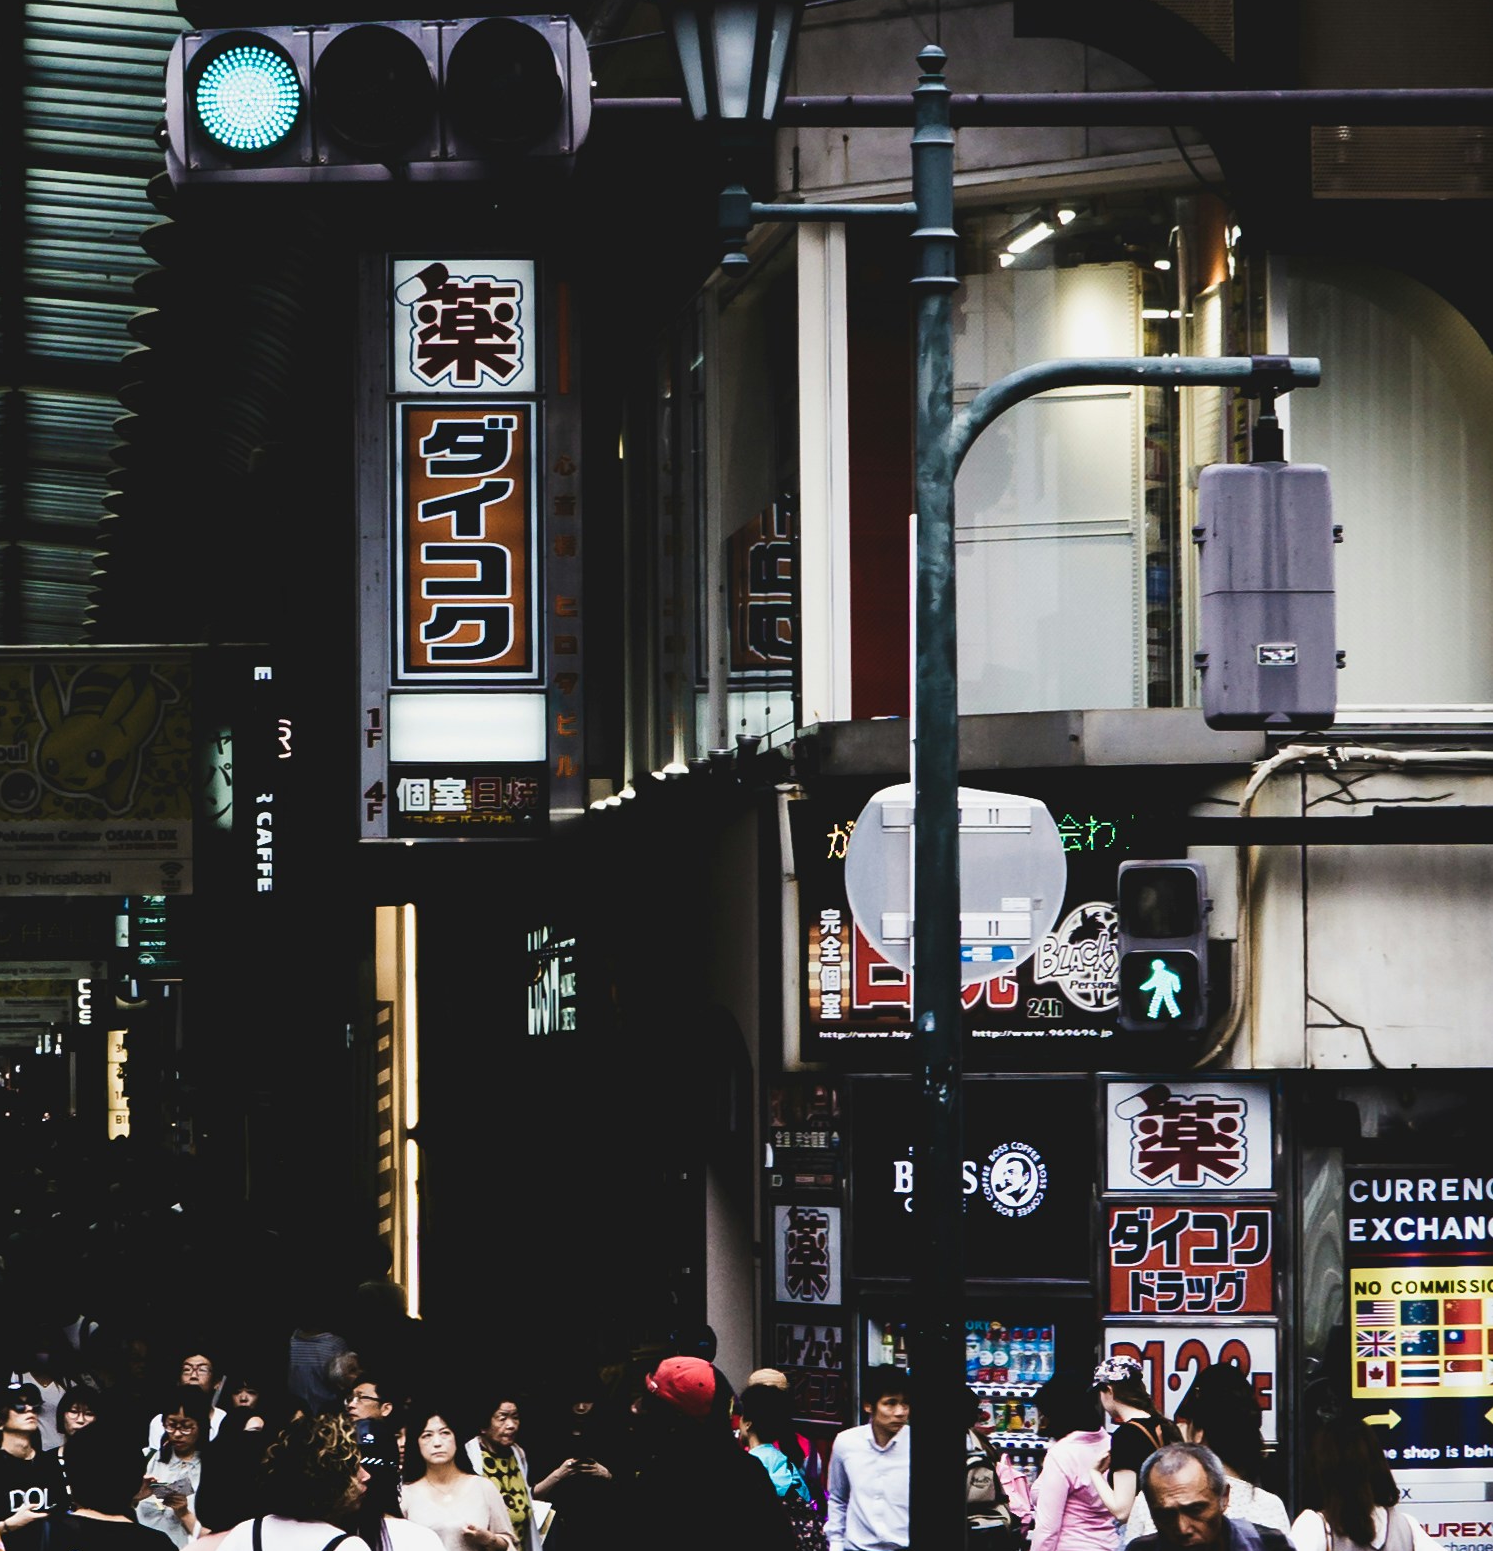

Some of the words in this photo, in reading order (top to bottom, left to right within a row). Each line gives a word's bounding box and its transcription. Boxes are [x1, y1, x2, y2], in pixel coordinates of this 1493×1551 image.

[414, 278, 520, 385] 薬
[418, 415, 518, 664] ダイコク
[366, 707, 383, 749] 1F
[364, 779, 386, 822] 4F
[256, 811, 273, 892] CAFFE
[7, 872, 20, 885] to
[26, 870, 111, 885] Shinsaibashi
[820, 909, 842, 1019] 完全個室
[1028, 998, 1064, 1018] 24h
[1134, 1096, 1245, 1185] 薬
[1109, 1207, 1272, 1267] ダイコク
[1129, 1270, 1247, 1313] ドラッグ
[1354, 1281, 1382, 1295] NO
[1403, 1445, 1441, 1459] shop
[1446, 1445, 1459, 1458] is
[1420, 1522, 1493, 1538] UREX
